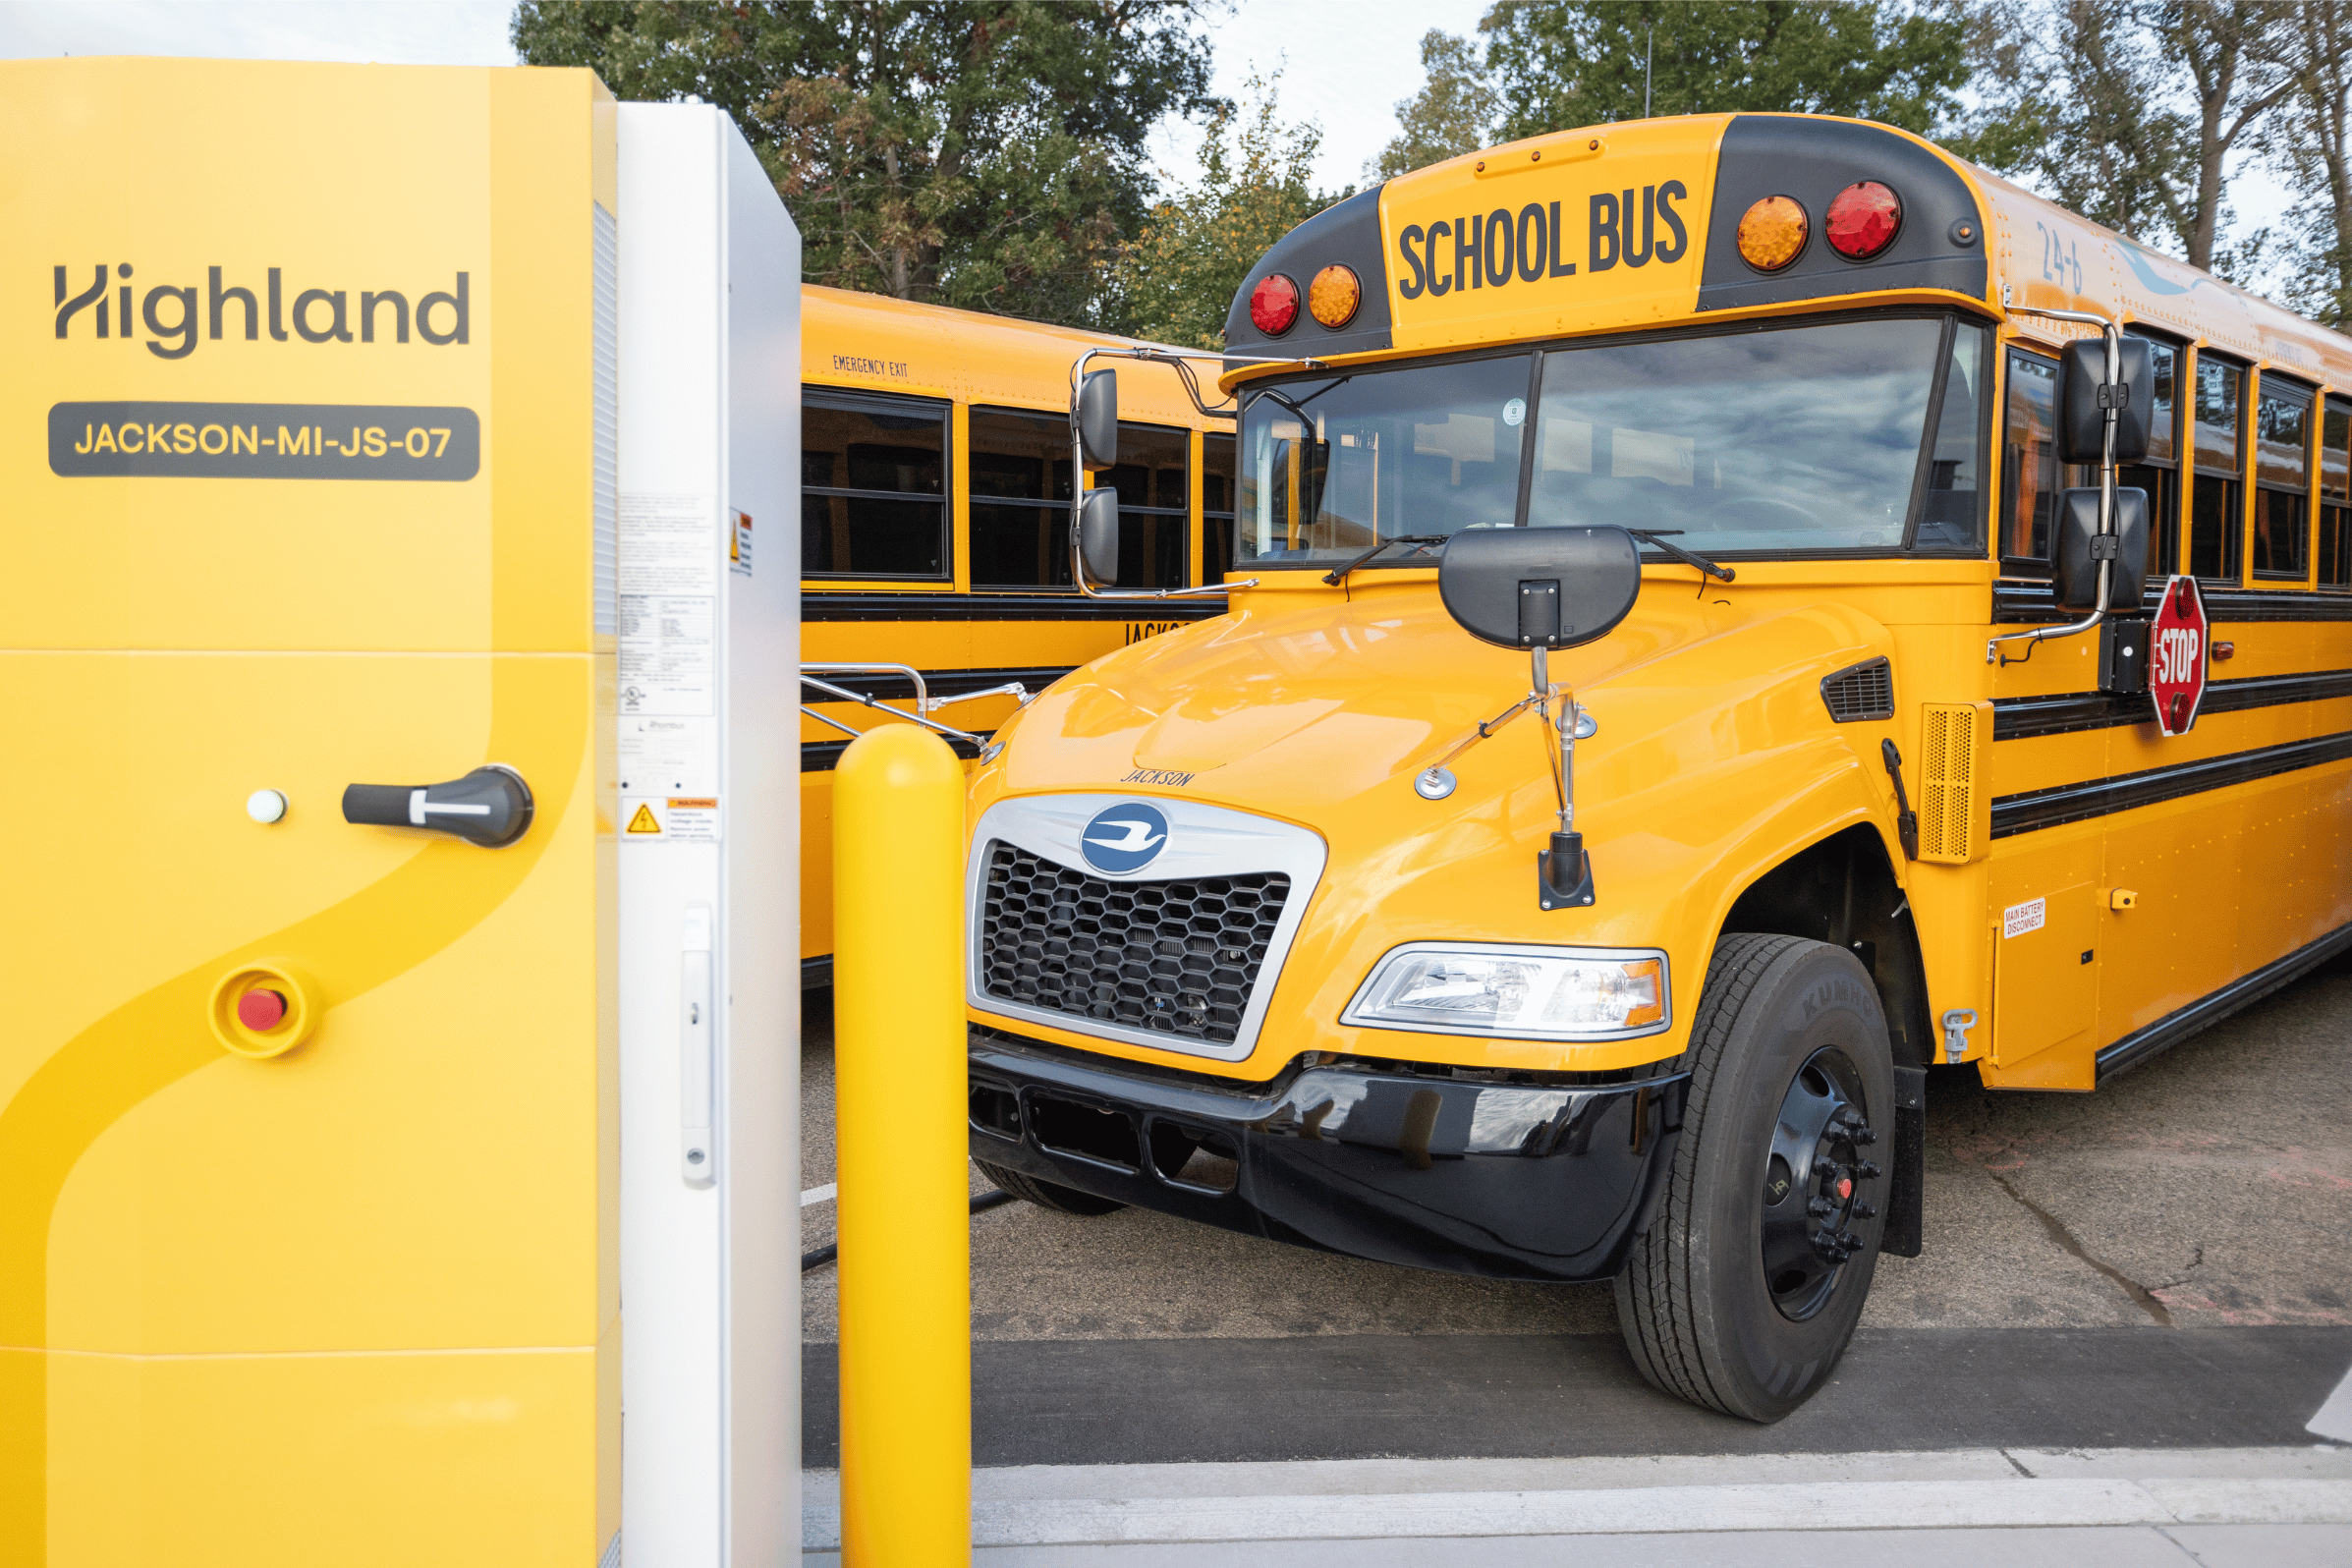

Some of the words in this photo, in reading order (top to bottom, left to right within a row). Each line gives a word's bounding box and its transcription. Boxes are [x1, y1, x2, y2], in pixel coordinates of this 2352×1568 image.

[1399, 200, 1576, 300] SCHOOL
[1589, 180, 1688, 273] BUS
[2037, 221, 2082, 295] 24-6
[53, 262, 470, 360] Highland
[833, 355, 885, 374] EMERGENCY
[889, 362, 908, 377] EXIT
[74, 422, 452, 459] JACKSON-MI-JS-07
[2158, 628, 2199, 684] STOP
[1120, 769, 1196, 787] JACKSON
[2005, 908, 2020, 923] MAIN
[2020, 900, 2044, 918] BATTERY
[2007, 914, 2043, 935] DISCONNECT
[1801, 980, 1873, 1022] KUMHO
